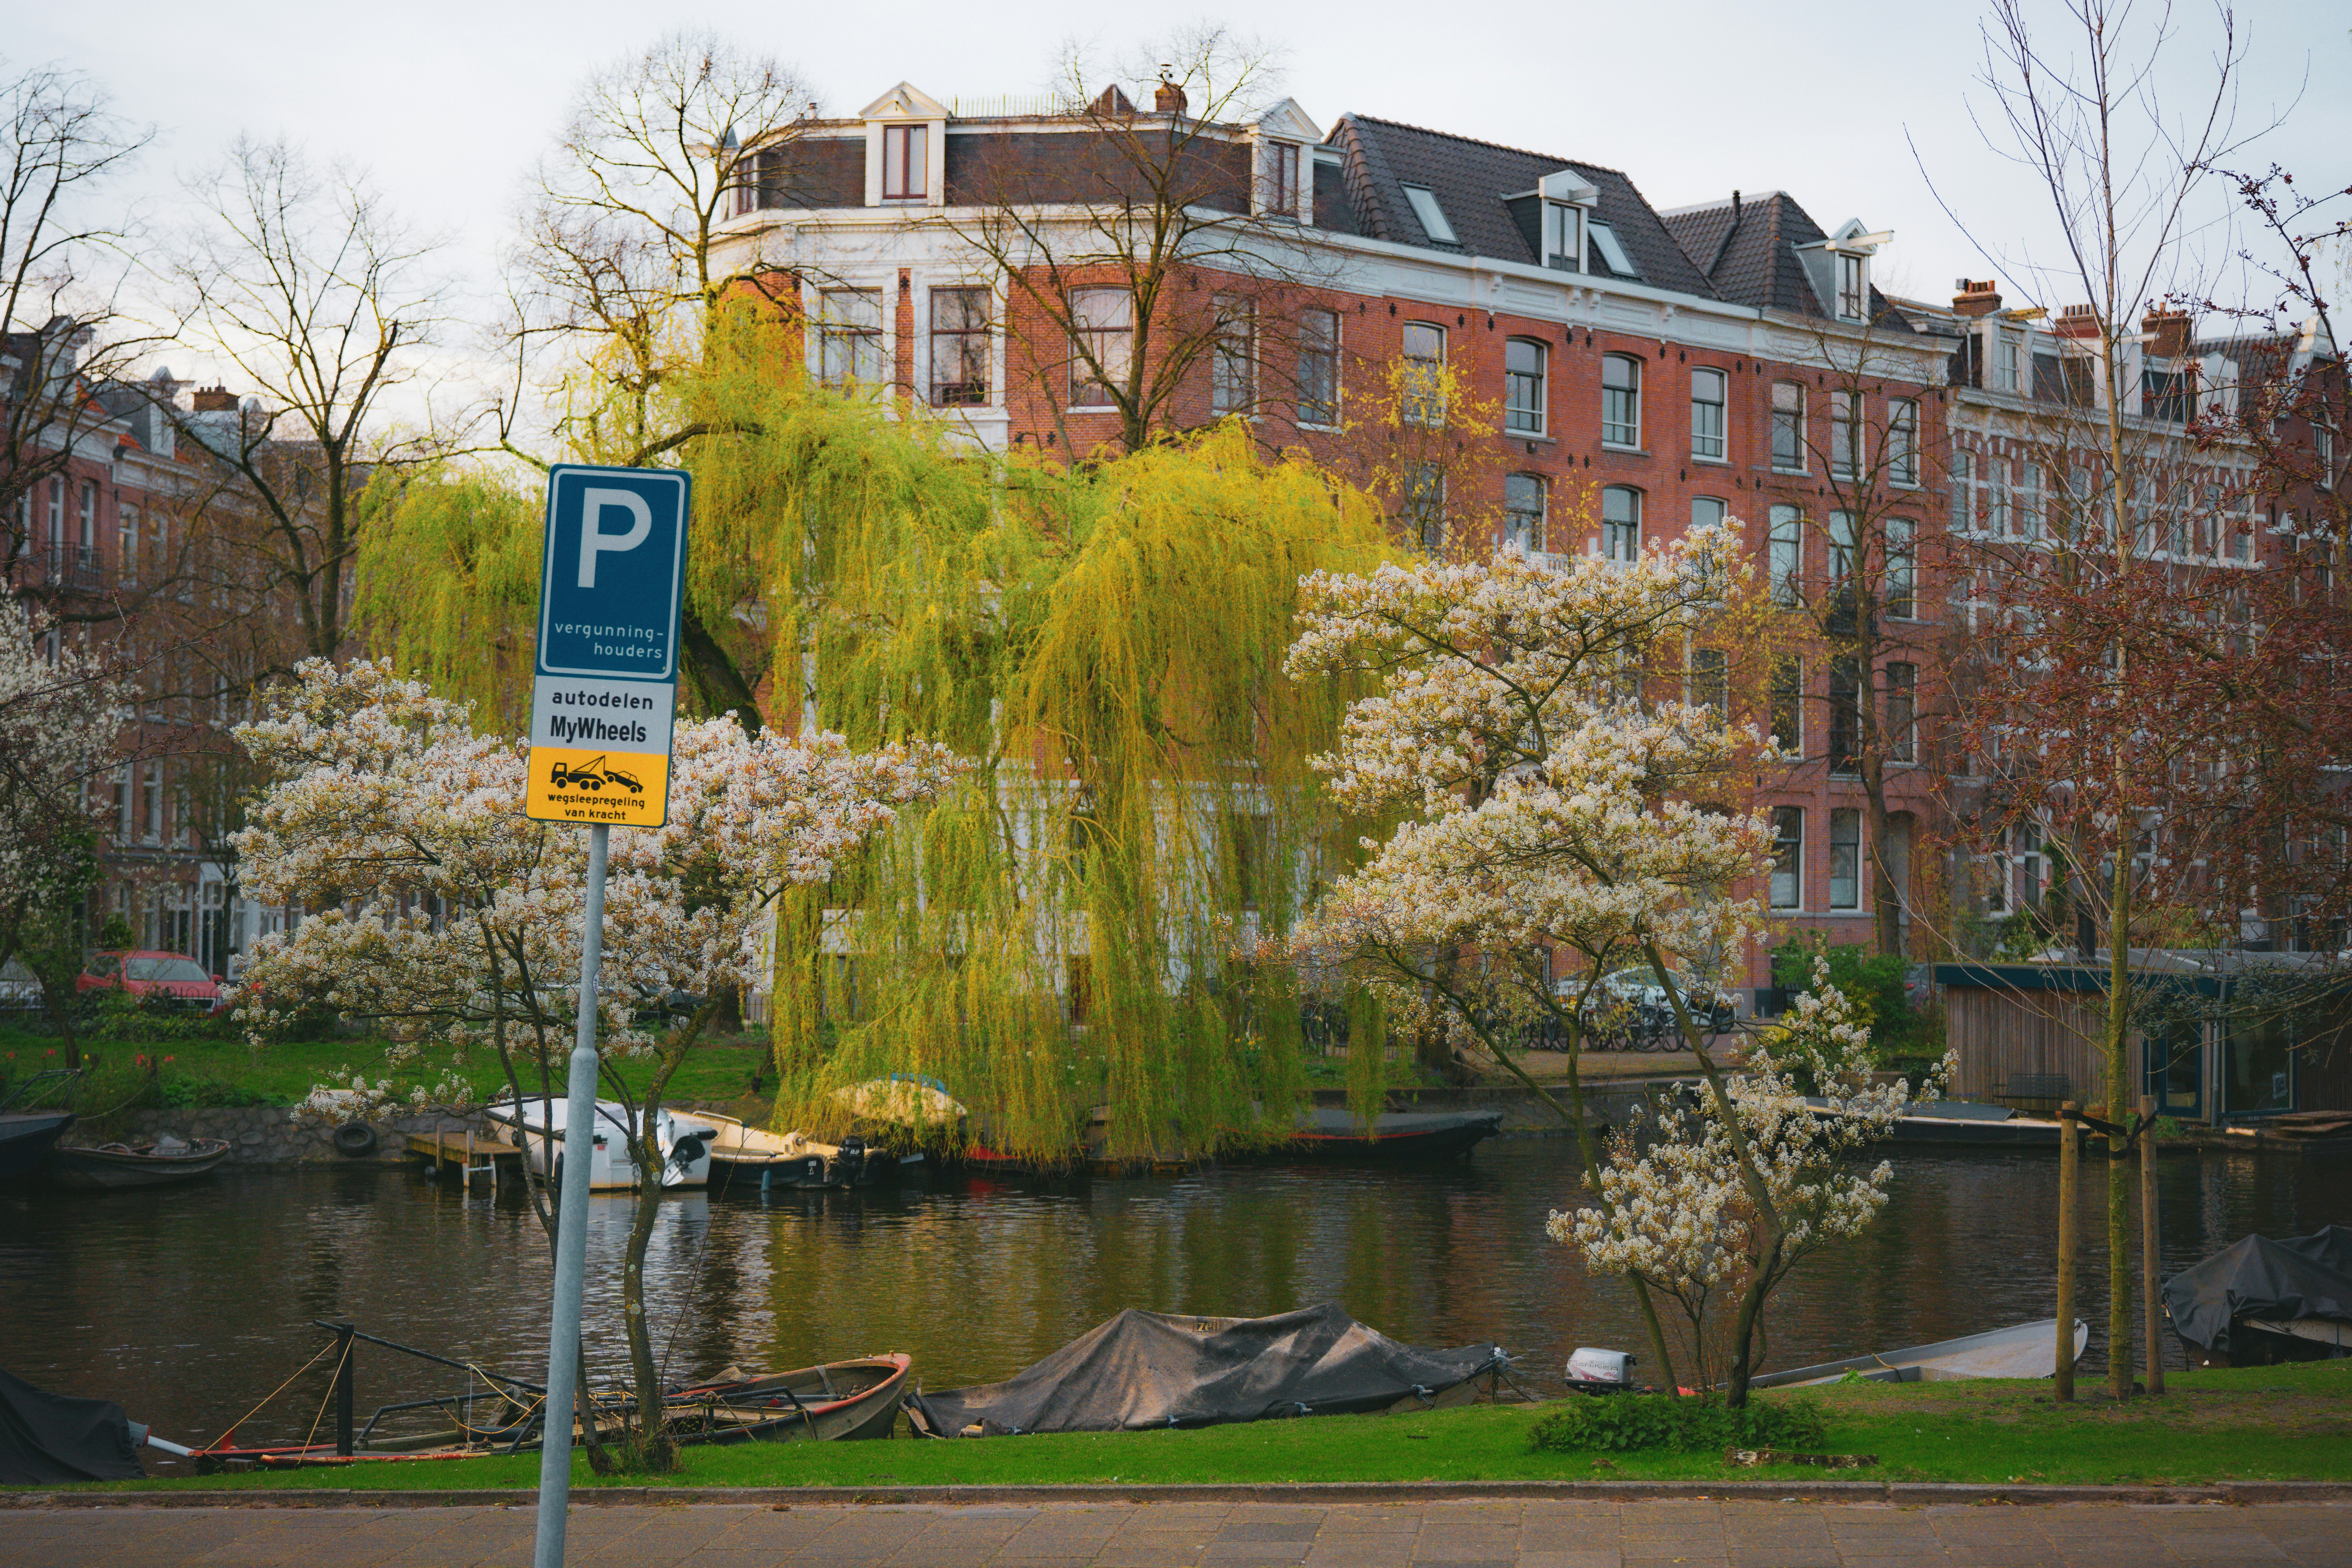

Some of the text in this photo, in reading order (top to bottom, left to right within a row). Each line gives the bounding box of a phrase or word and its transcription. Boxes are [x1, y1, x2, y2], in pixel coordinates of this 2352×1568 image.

[578, 487, 652, 588] P
[555, 623, 664, 642] vergunning-
[594, 642, 662, 659] houders
[552, 690, 653, 710] autodelen
[550, 715, 646, 744] MyWheels
[547, 793, 645, 810] wegsleepregeling
[564, 809, 626, 820] van kracht
[1569, 1361, 1619, 1371] MARINER
